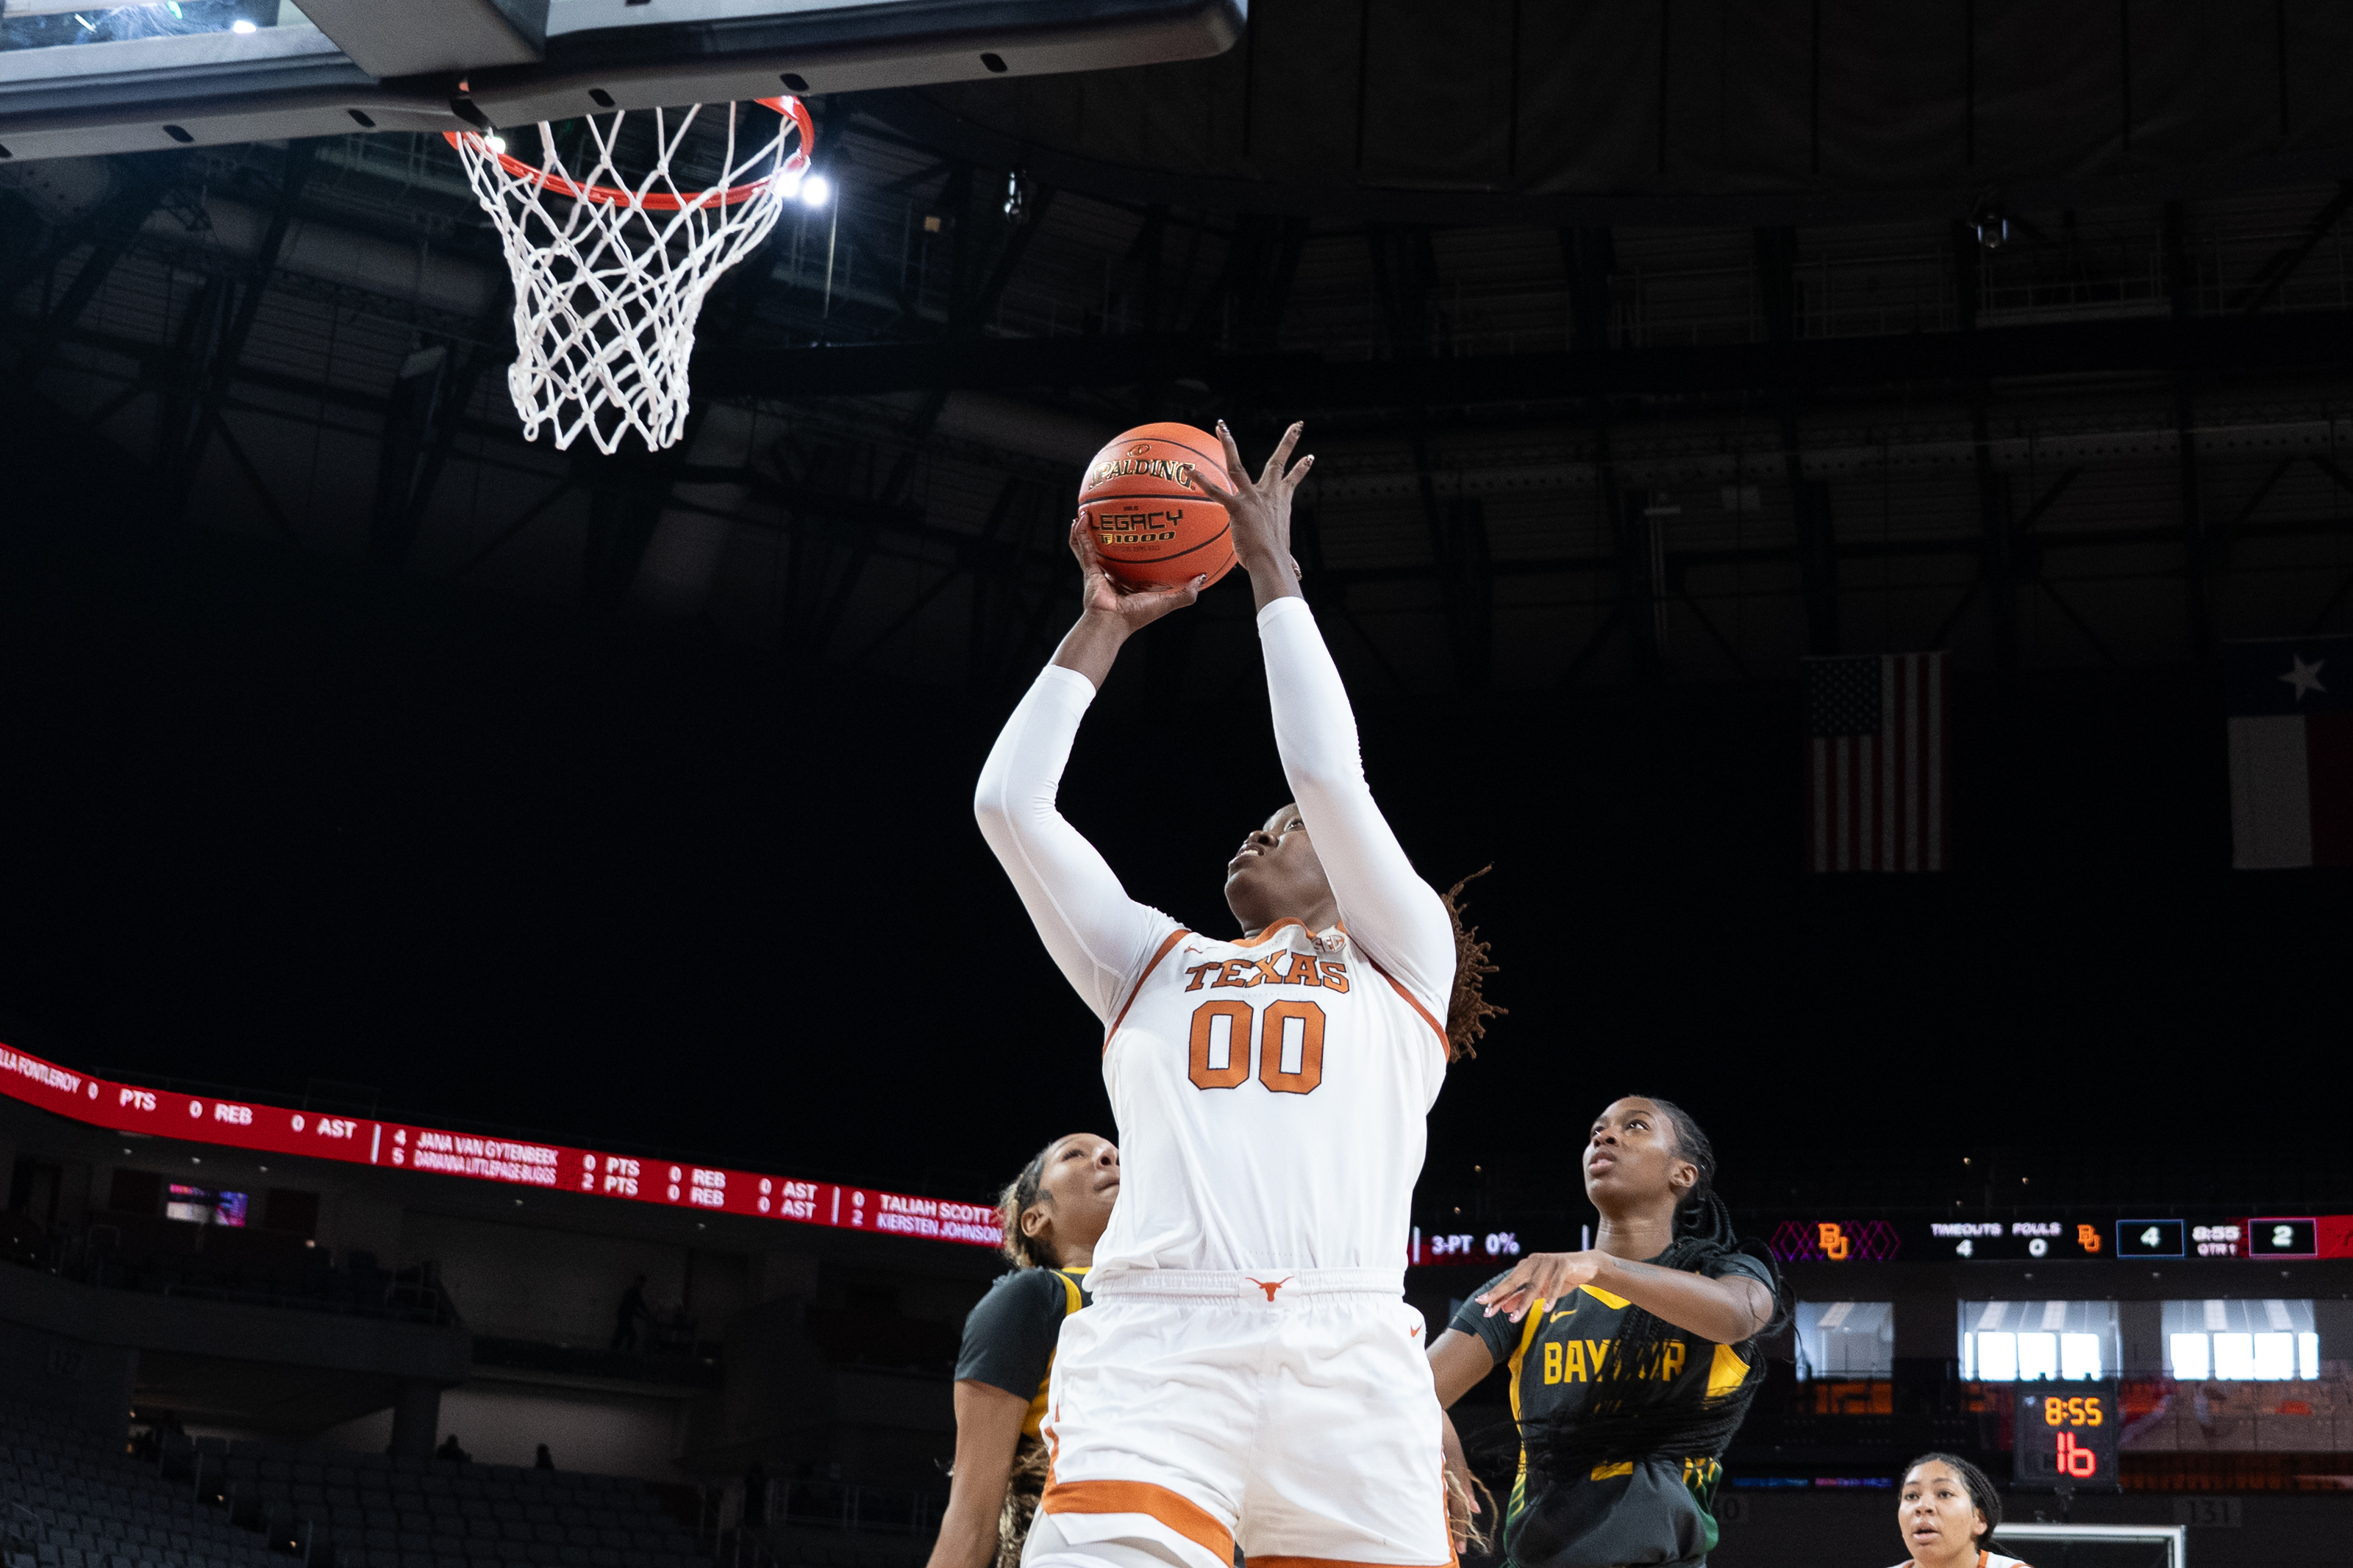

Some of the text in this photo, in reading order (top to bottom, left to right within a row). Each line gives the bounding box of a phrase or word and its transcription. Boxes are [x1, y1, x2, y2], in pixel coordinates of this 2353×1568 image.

[1090, 509, 1183, 531] LEGACY
[1185, 948, 1350, 994] TEXAS
[1189, 1000, 1326, 1095] 00
[88, 1081, 99, 1100] 0
[119, 1088, 157, 1111] PTS
[189, 1100, 203, 1119] 0
[214, 1103, 253, 1125] REB
[290, 1114, 305, 1132] 0
[317, 1117, 357, 1139] AST
[393, 1129, 407, 1146] 4
[416, 1131, 453, 1153] JANA
[454, 1136, 484, 1158] VAN
[582, 1153, 596, 1172] 0
[605, 1156, 640, 1178] PTS
[668, 1165, 682, 1184] 0
[691, 1168, 726, 1189] REB
[758, 1178, 772, 1196] 0
[781, 1181, 818, 1201] AST
[391, 1147, 404, 1166] 5
[581, 1172, 594, 1191] 2
[603, 1175, 638, 1197] PTS
[667, 1184, 680, 1203] 0
[689, 1186, 724, 1209] REB
[757, 1195, 771, 1214] 0
[779, 1198, 817, 1220] AST
[851, 1191, 993, 1225] 0 TALIAH SCOTT
[851, 1209, 1003, 1244] 2 KIERSTEN JOHNSON
[1930, 1222, 2063, 1237] TIMEOUTS FOULS
[2140, 1226, 2160, 1247] 4
[2192, 1225, 2242, 1242] 8:55
[2271, 1225, 2294, 1247] 2
[1432, 1232, 1520, 1256] 3-PT 0%
[1956, 1238, 2049, 1259] 4 0
[1544, 1339, 1685, 1385] BAYR
[2045, 1397, 2103, 1426] 8:55
[2057, 1431, 2096, 1478] 16
